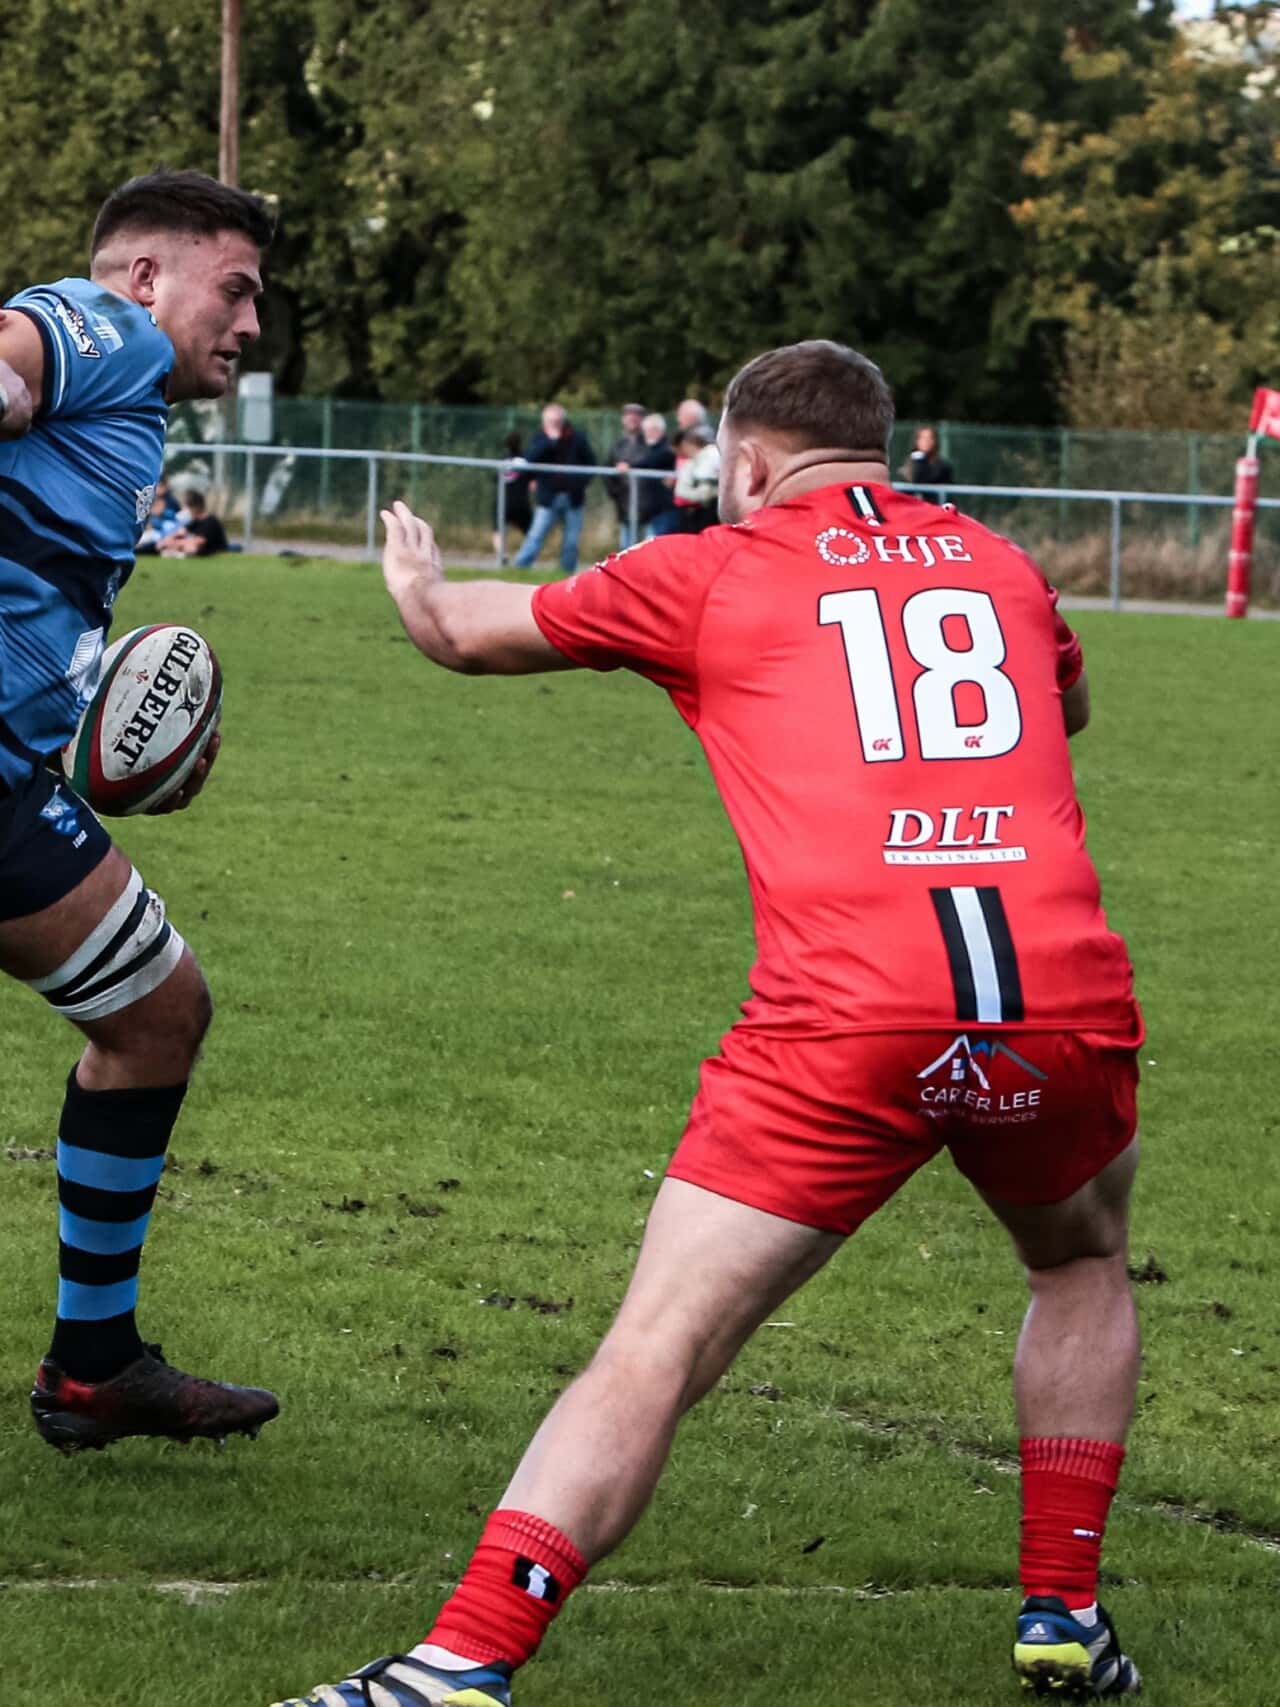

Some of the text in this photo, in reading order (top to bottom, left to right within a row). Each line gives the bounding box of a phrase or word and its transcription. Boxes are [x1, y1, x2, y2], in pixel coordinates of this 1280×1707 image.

[871, 535, 973, 567] HJE
[817, 586, 1024, 764] 18
[113, 632, 200, 769] GILBERT
[883, 805, 1015, 849] DLT
[889, 849, 1023, 862] TRAINING LTD
[920, 1086, 1041, 1111] CARER LEE
